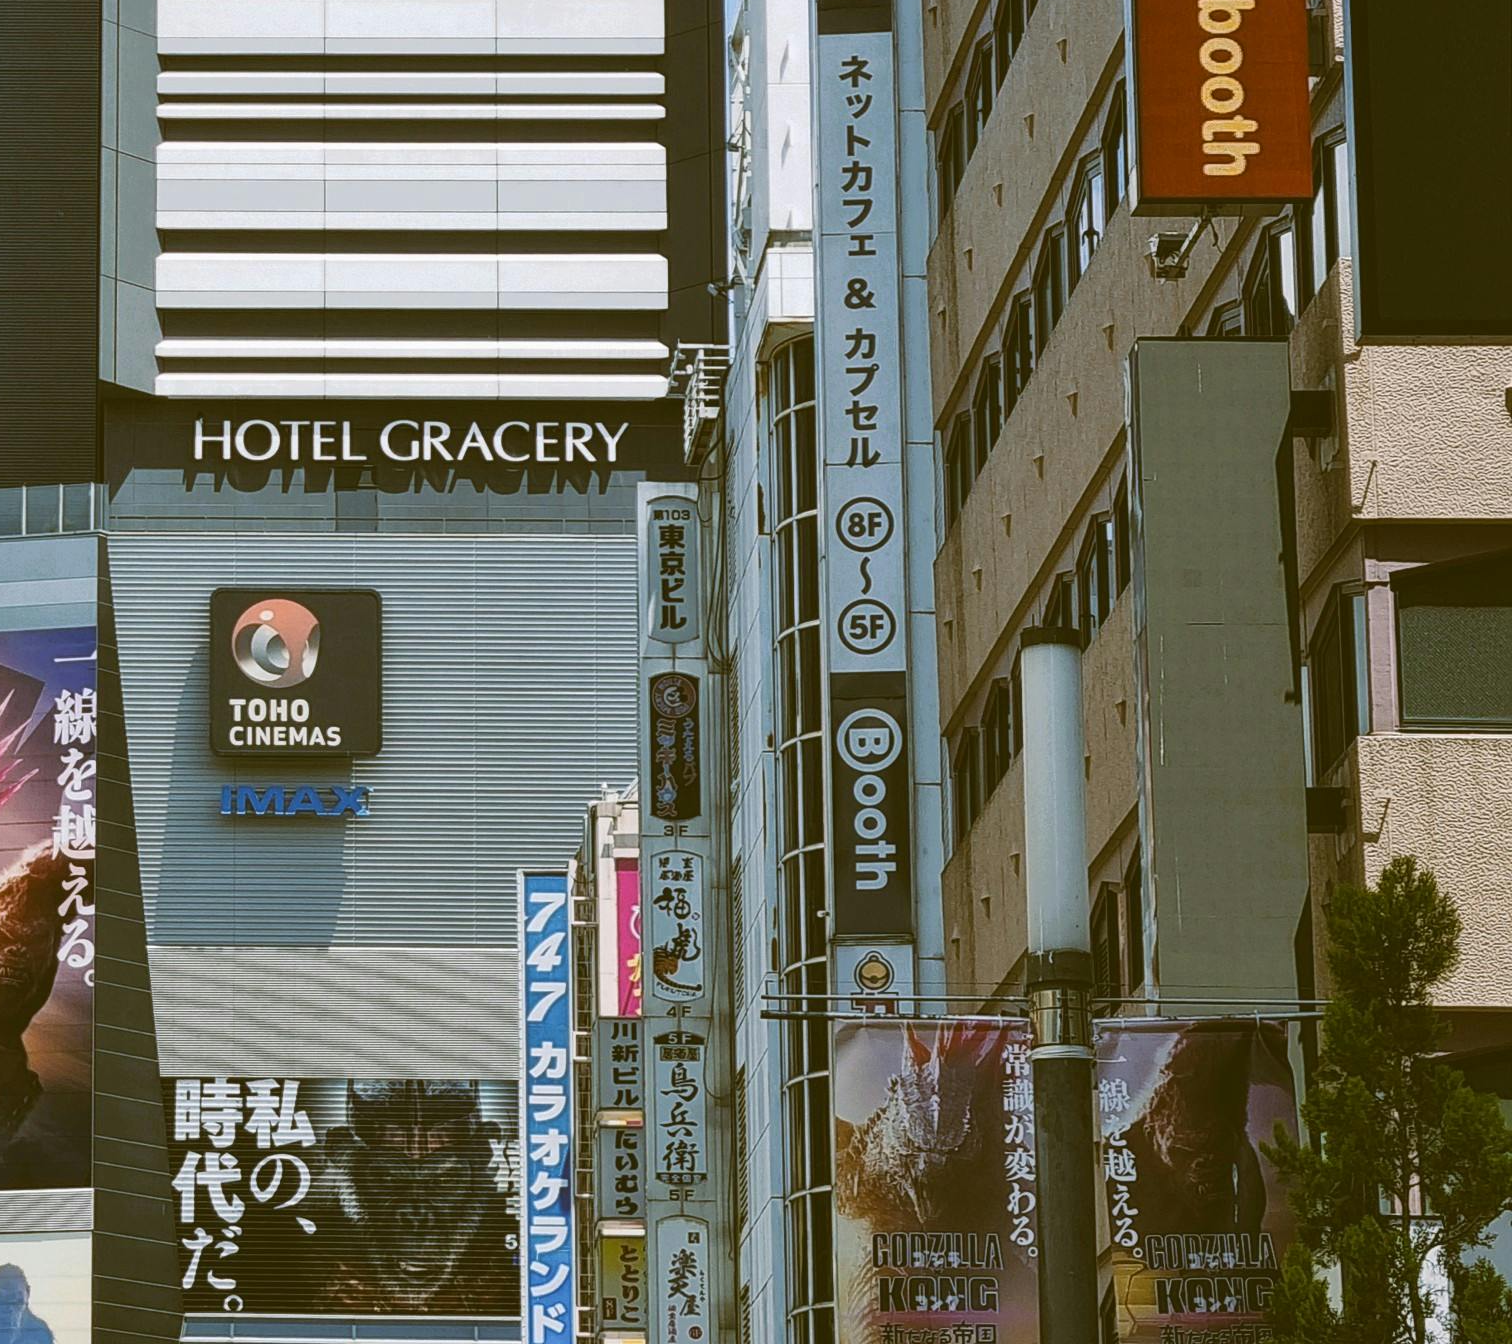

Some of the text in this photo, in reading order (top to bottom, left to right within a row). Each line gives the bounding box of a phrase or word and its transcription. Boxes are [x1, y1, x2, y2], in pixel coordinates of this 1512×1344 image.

[838, 54, 883, 470] ネットカフェ & カプセル
[193, 419, 630, 463] HOTEL GRACERY
[847, 512, 884, 537] 8F
[658, 525, 687, 631] 東京ビル
[849, 614, 885, 639] 5F
[228, 698, 311, 723] TOHO
[228, 726, 342, 747] CINEMAS
[220, 784, 375, 816] IMAX
[836, 708, 904, 892] Booth
[663, 825, 689, 837] 3F
[666, 1006, 692, 1017] 4F
[668, 1033, 692, 1044] 5F
[611, 1023, 639, 1107] 川新ビル
[526, 892, 570, 1344] 747 カラオケランド
[245, 1078, 317, 1235] 私の、
[1001, 1043, 1039, 1258] 常識が変わる。
[615, 1131, 639, 1216] にいむら
[172, 1078, 245, 1312] 時代だ。
[669, 1189, 694, 1202] 5F
[871, 1231, 1004, 1272] GODZILLA
[1143, 1232, 1278, 1272] GODZILLA
[619, 1244, 640, 1324] ととりこ
[877, 1276, 1001, 1314] KONG
[1156, 1277, 1275, 1314] KONG
